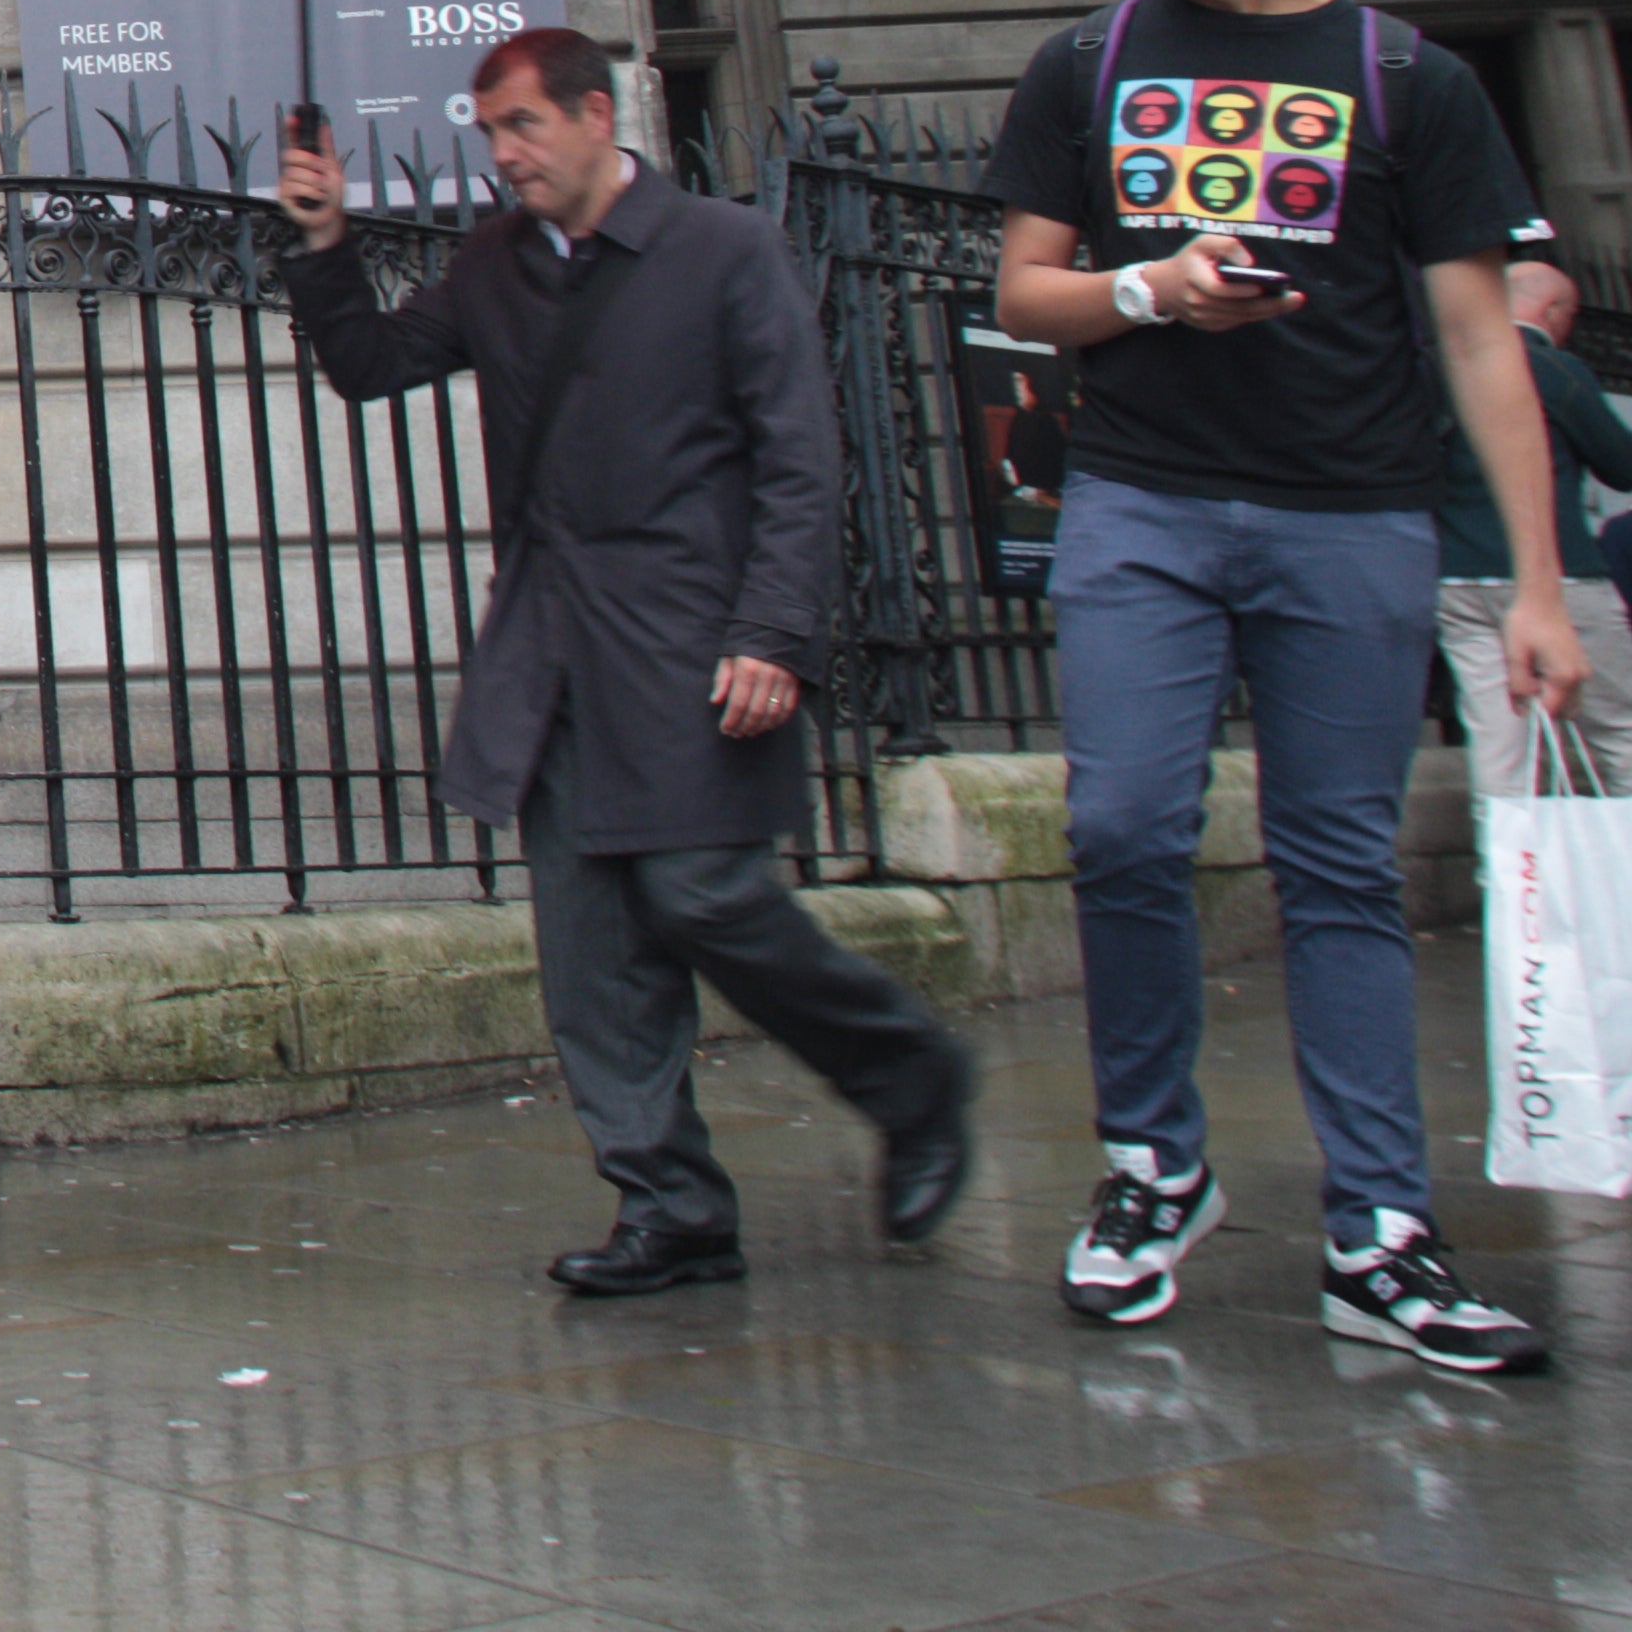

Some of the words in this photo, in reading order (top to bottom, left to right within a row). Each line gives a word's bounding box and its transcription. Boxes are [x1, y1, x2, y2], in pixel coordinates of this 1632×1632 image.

[407, 1, 525, 36] BOSS
[60, 23, 111, 47] FREE
[117, 20, 165, 43] FOR
[411, 37, 463, 47] HUGO
[474, 35, 512, 45] BOS
[62, 50, 173, 77] MEMBERS
